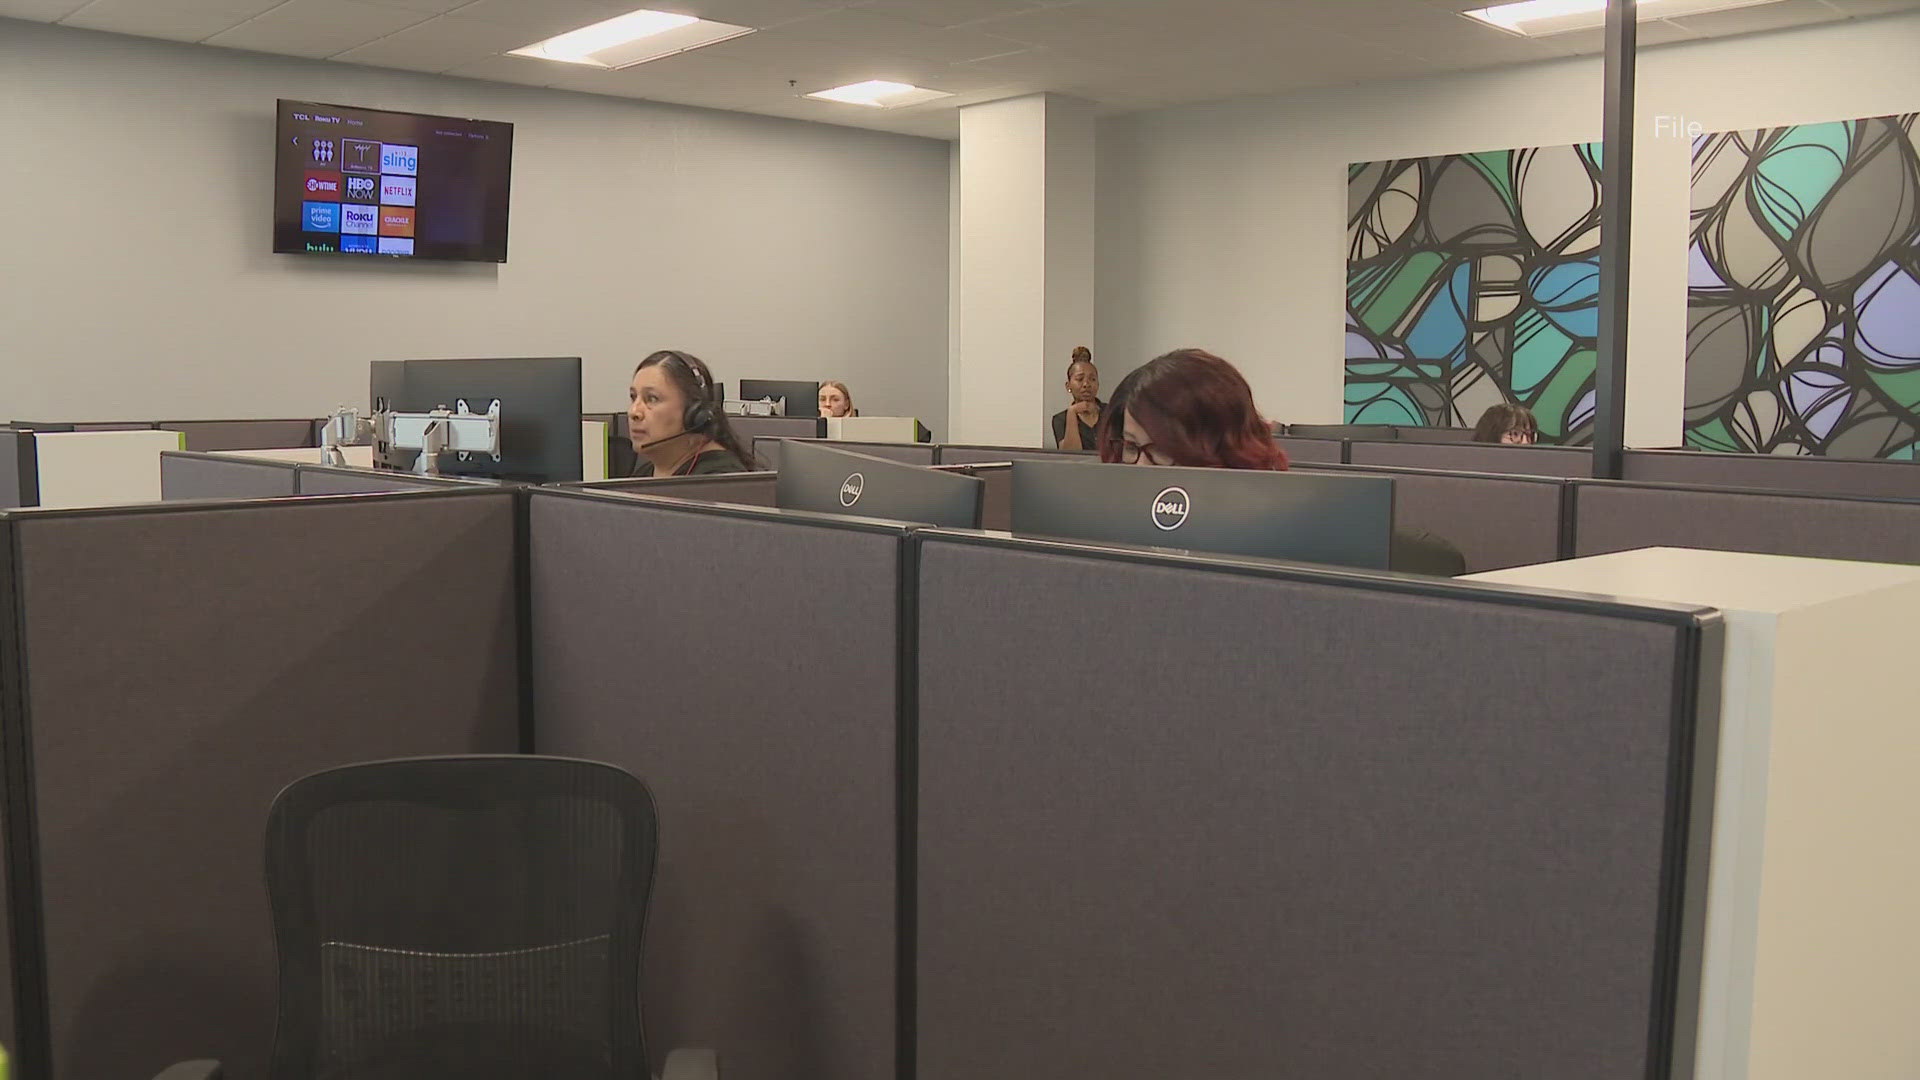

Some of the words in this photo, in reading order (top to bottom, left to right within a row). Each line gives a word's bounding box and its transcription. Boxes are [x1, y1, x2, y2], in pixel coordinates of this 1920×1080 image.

[383, 153, 416, 171] sling
[347, 177, 374, 190] HBO
[347, 190, 374, 199] NOW
[384, 186, 412, 197] NETFLIX
[311, 207, 332, 216] prime
[311, 215, 332, 223] video
[346, 221, 373, 229] Channel
[844, 484, 858, 496] DELL
[1156, 502, 1185, 515] DELL
